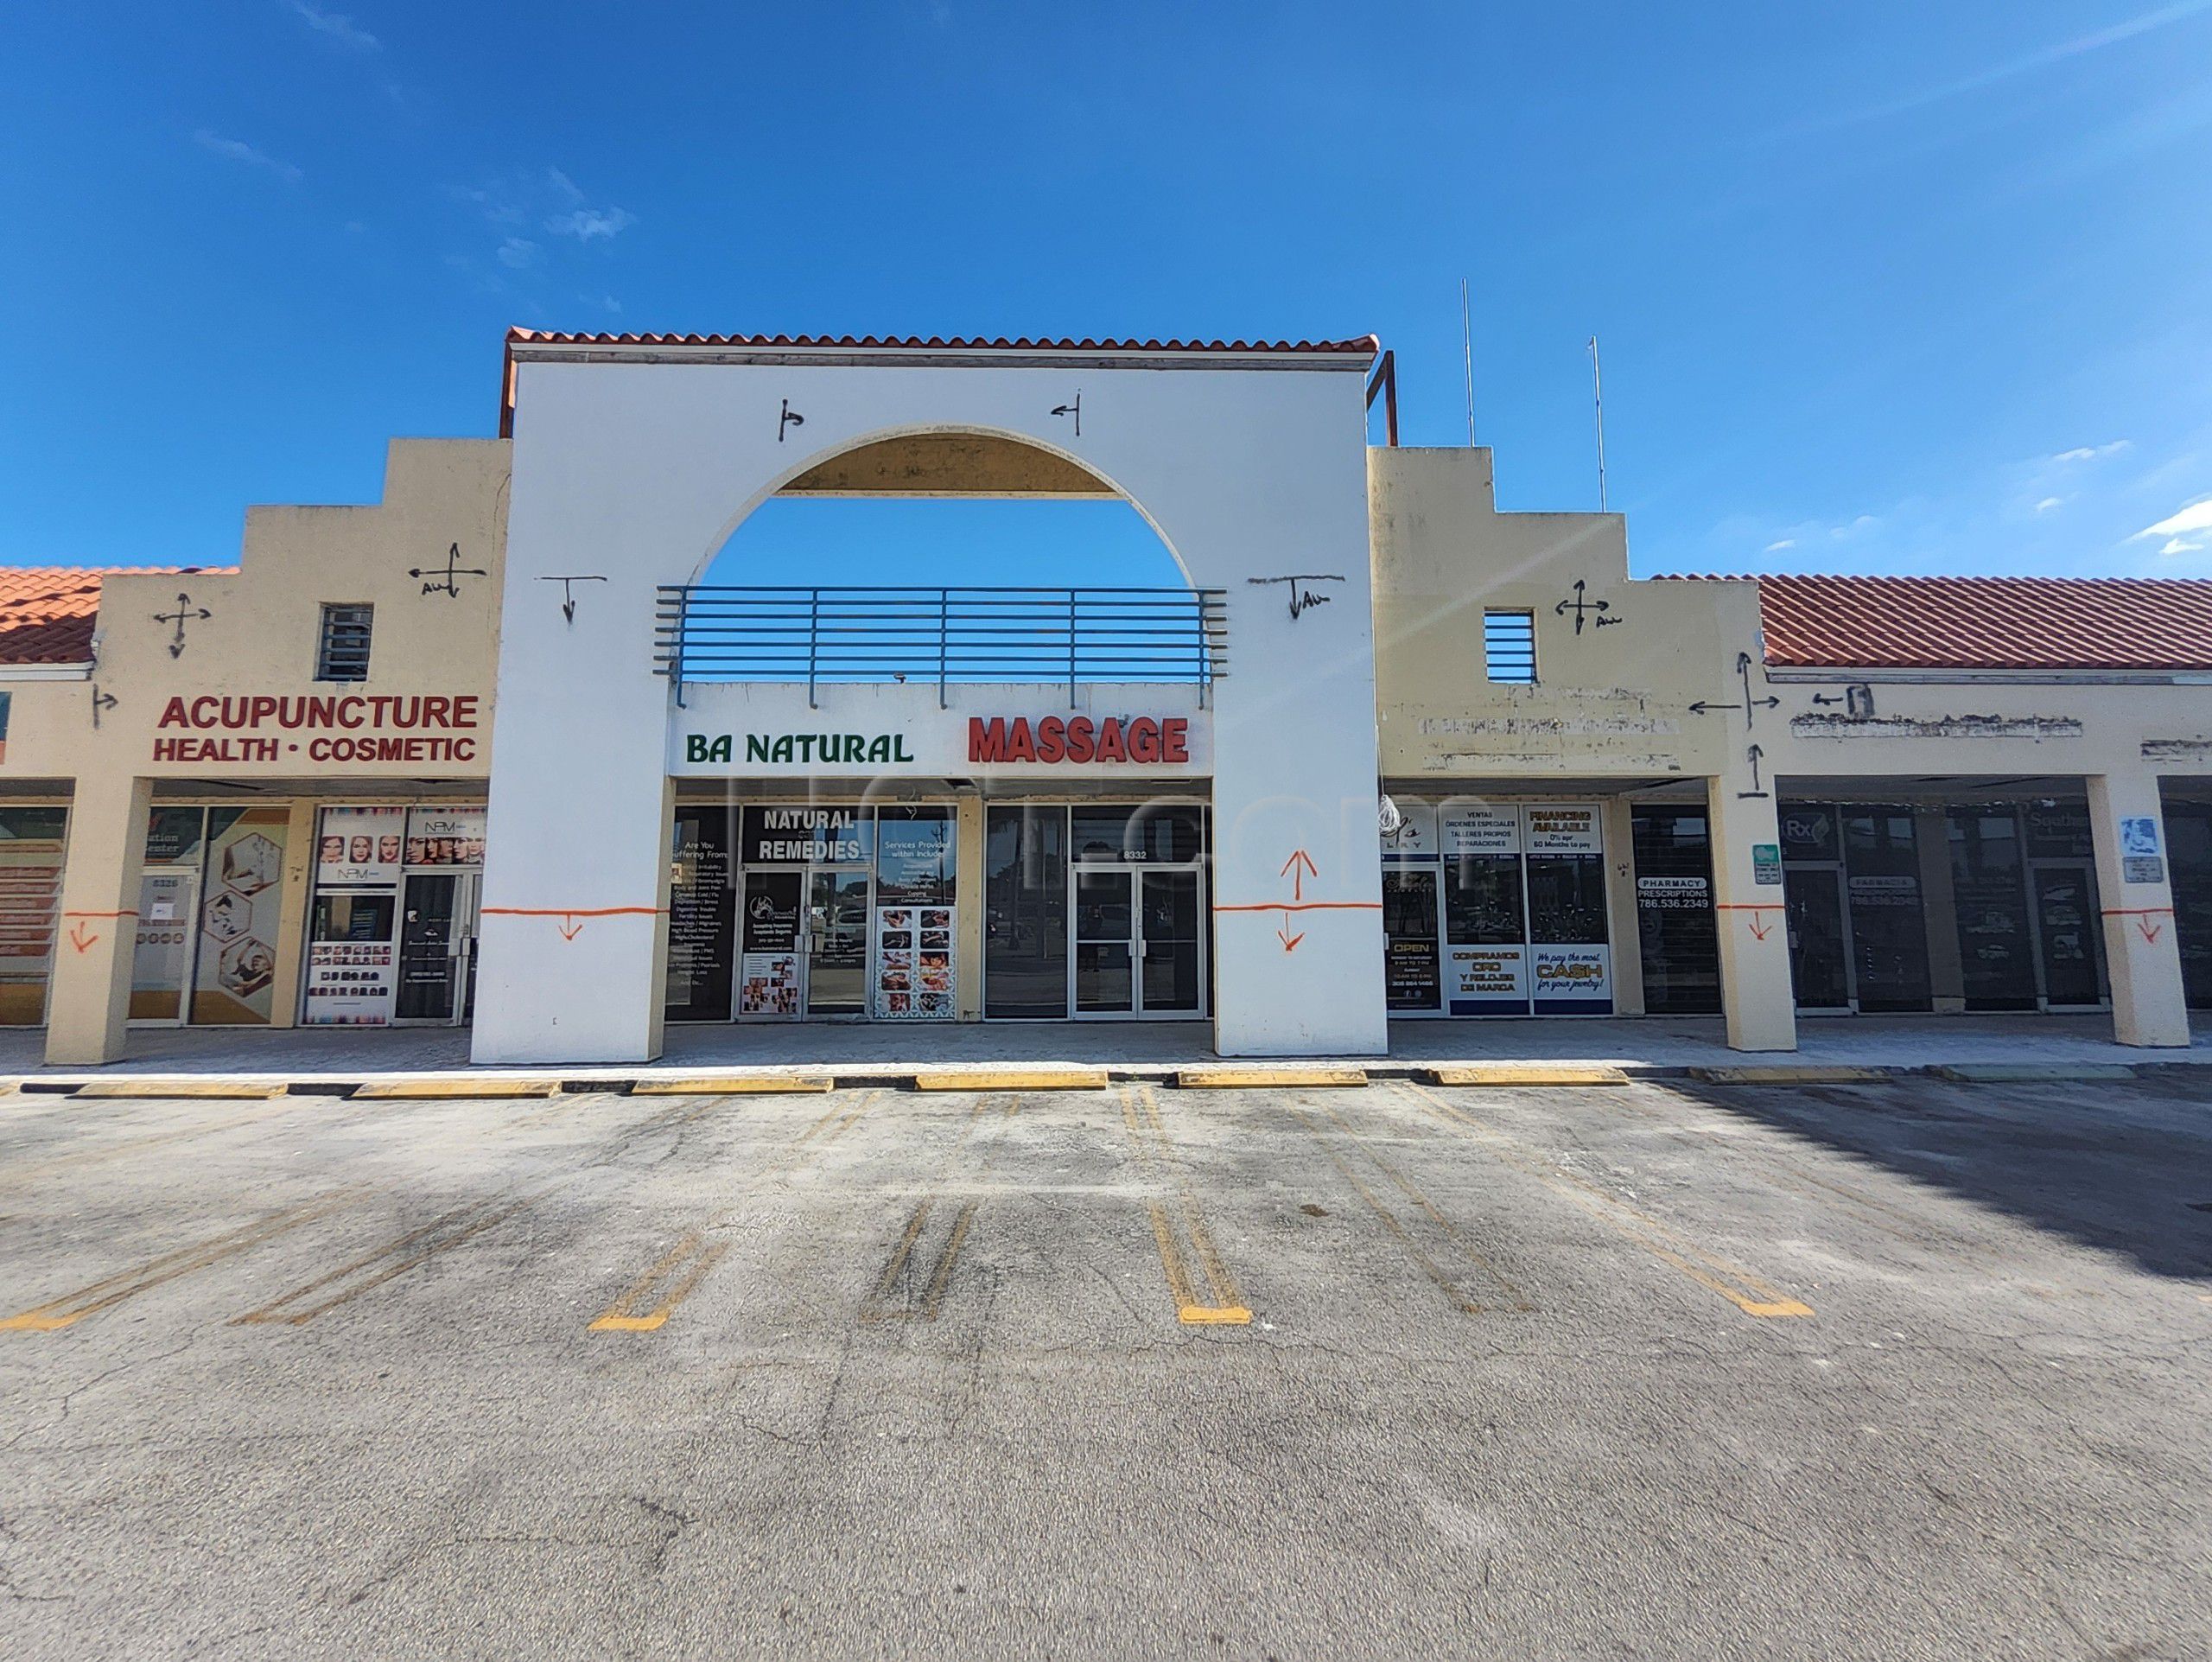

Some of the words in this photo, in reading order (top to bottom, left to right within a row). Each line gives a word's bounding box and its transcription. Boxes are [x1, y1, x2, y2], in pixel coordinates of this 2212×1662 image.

[158, 696, 479, 729] ACUPUNCTURE
[968, 716, 1190, 764] MASSAGE
[153, 738, 278, 761] HEALTH
[309, 737, 476, 761] COSMETIC
[687, 734, 732, 763] BA
[745, 733, 914, 764] NATURAL
[764, 810, 855, 830] NATURAL
[1529, 811, 1592, 822] FINANCING
[1532, 822, 1591, 833] AVAILABLE
[1786, 819, 1811, 837] Rx
[685, 841, 698, 850] Are
[700, 841, 715, 850] You
[759, 840, 860, 860] REMEDIES
[1123, 850, 1147, 861] 8332
[1638, 899, 1709, 908] 786.536.2349
[1394, 944, 1430, 952] OPEN
[1550, 954, 1566, 965] pay
[1567, 952, 1580, 961] the
[1581, 952, 1600, 961] most
[1472, 962, 1502, 971] ORO
[1460, 984, 1475, 992] DE
[1476, 984, 1516, 992] MARCA
[1537, 979, 1550, 991] for
[1551, 981, 1570, 991] your
[1569, 978, 1604, 992] jewelry!
